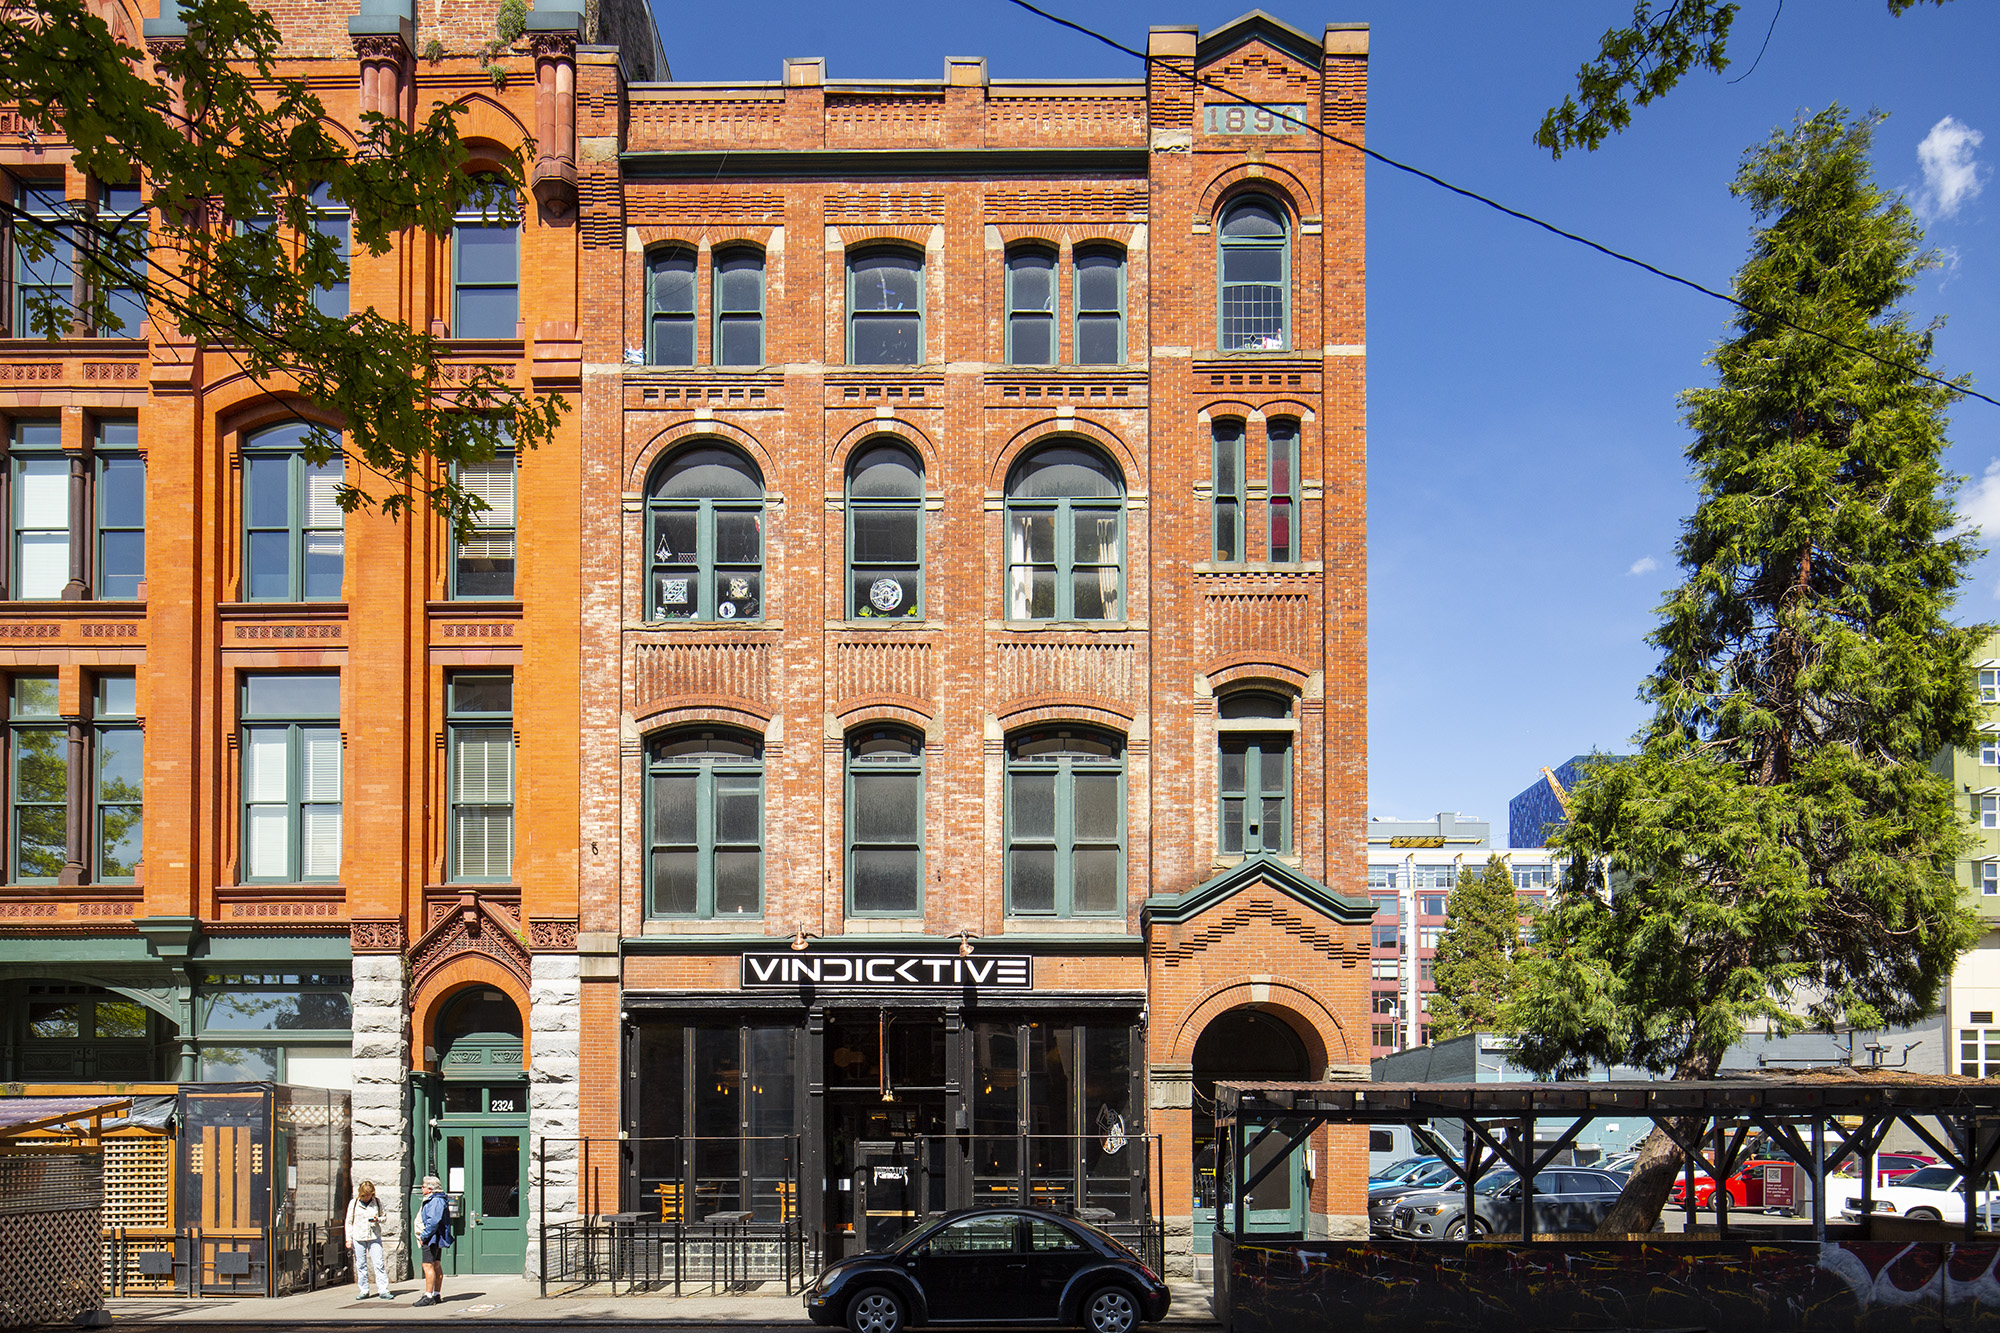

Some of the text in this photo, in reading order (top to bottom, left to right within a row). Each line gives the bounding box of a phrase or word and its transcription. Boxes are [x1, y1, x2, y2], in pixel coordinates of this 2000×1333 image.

[1207, 107, 1303, 133] 1890
[749, 958, 1027, 984] VINDICKTIVE
[491, 1100, 514, 1111] 2324
